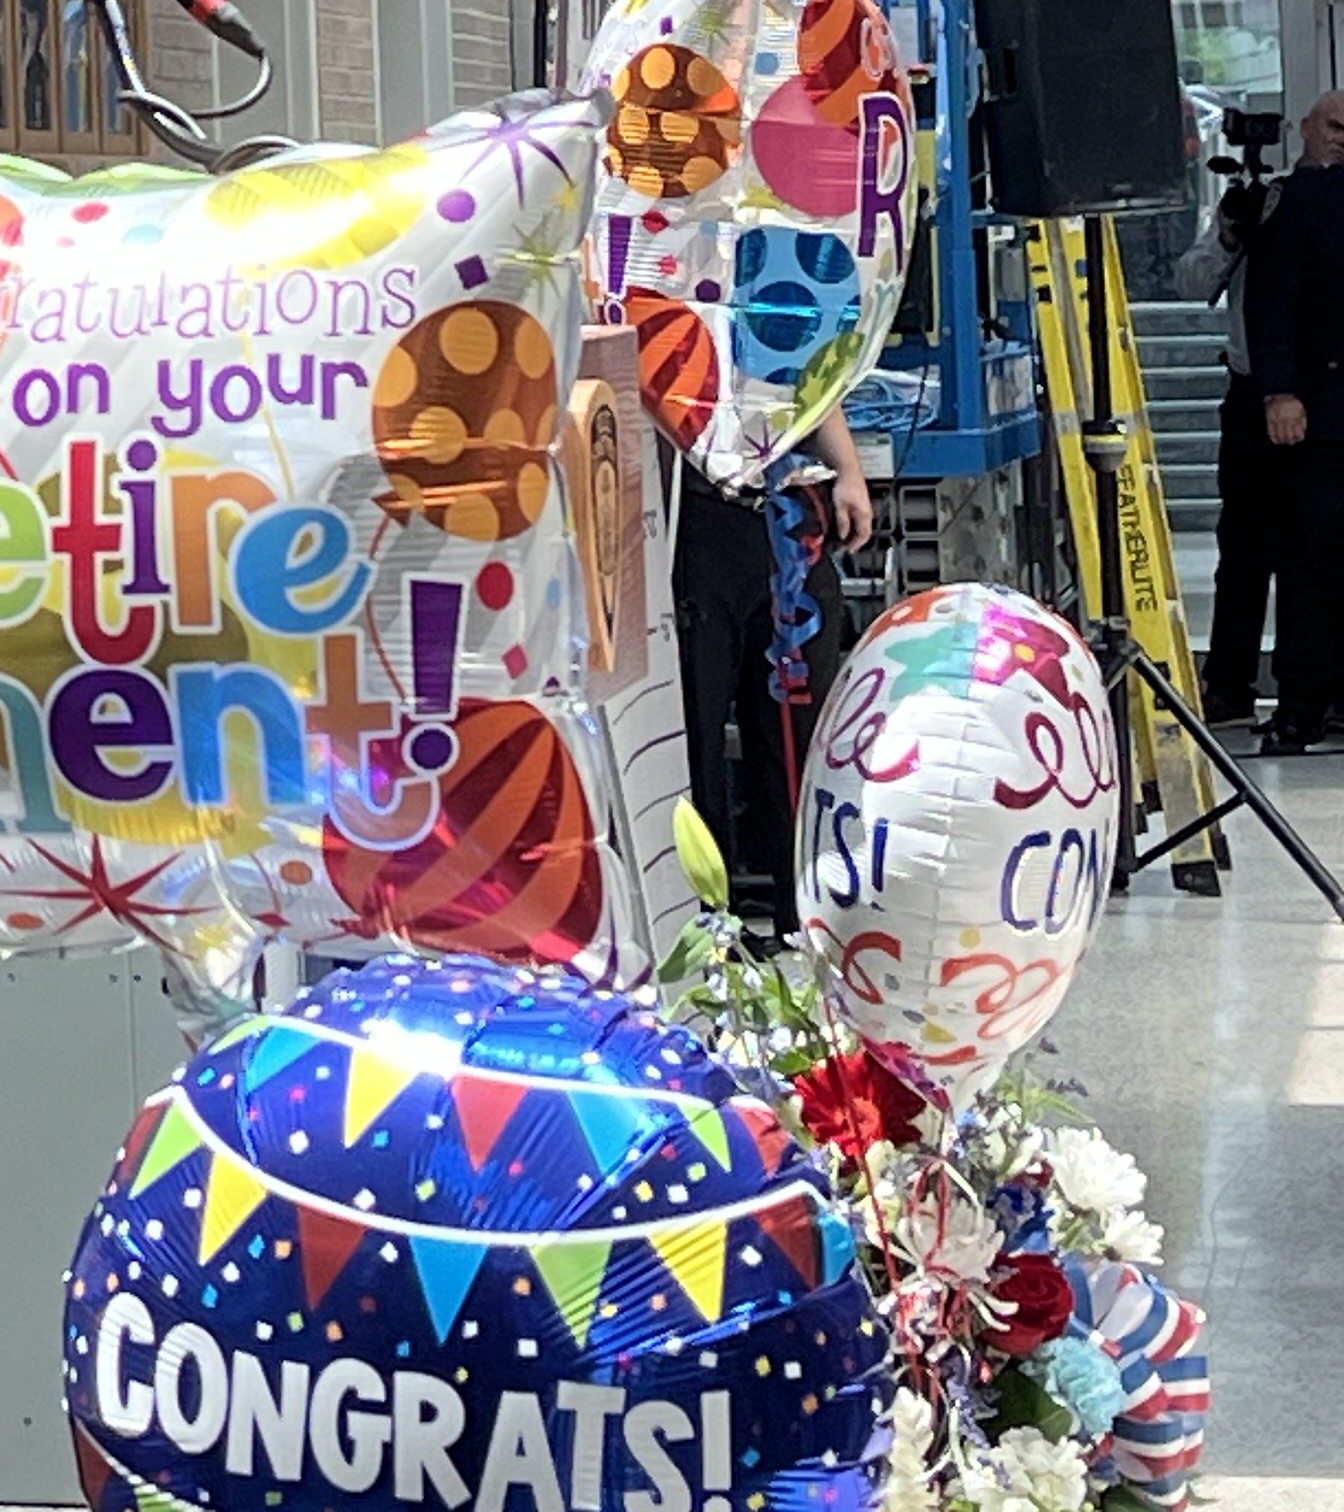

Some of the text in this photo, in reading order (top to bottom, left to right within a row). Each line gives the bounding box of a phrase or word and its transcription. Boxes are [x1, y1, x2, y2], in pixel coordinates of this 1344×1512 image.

[12, 351, 369, 439] on your
[95, 1292, 734, 1512] CONGRATS!
